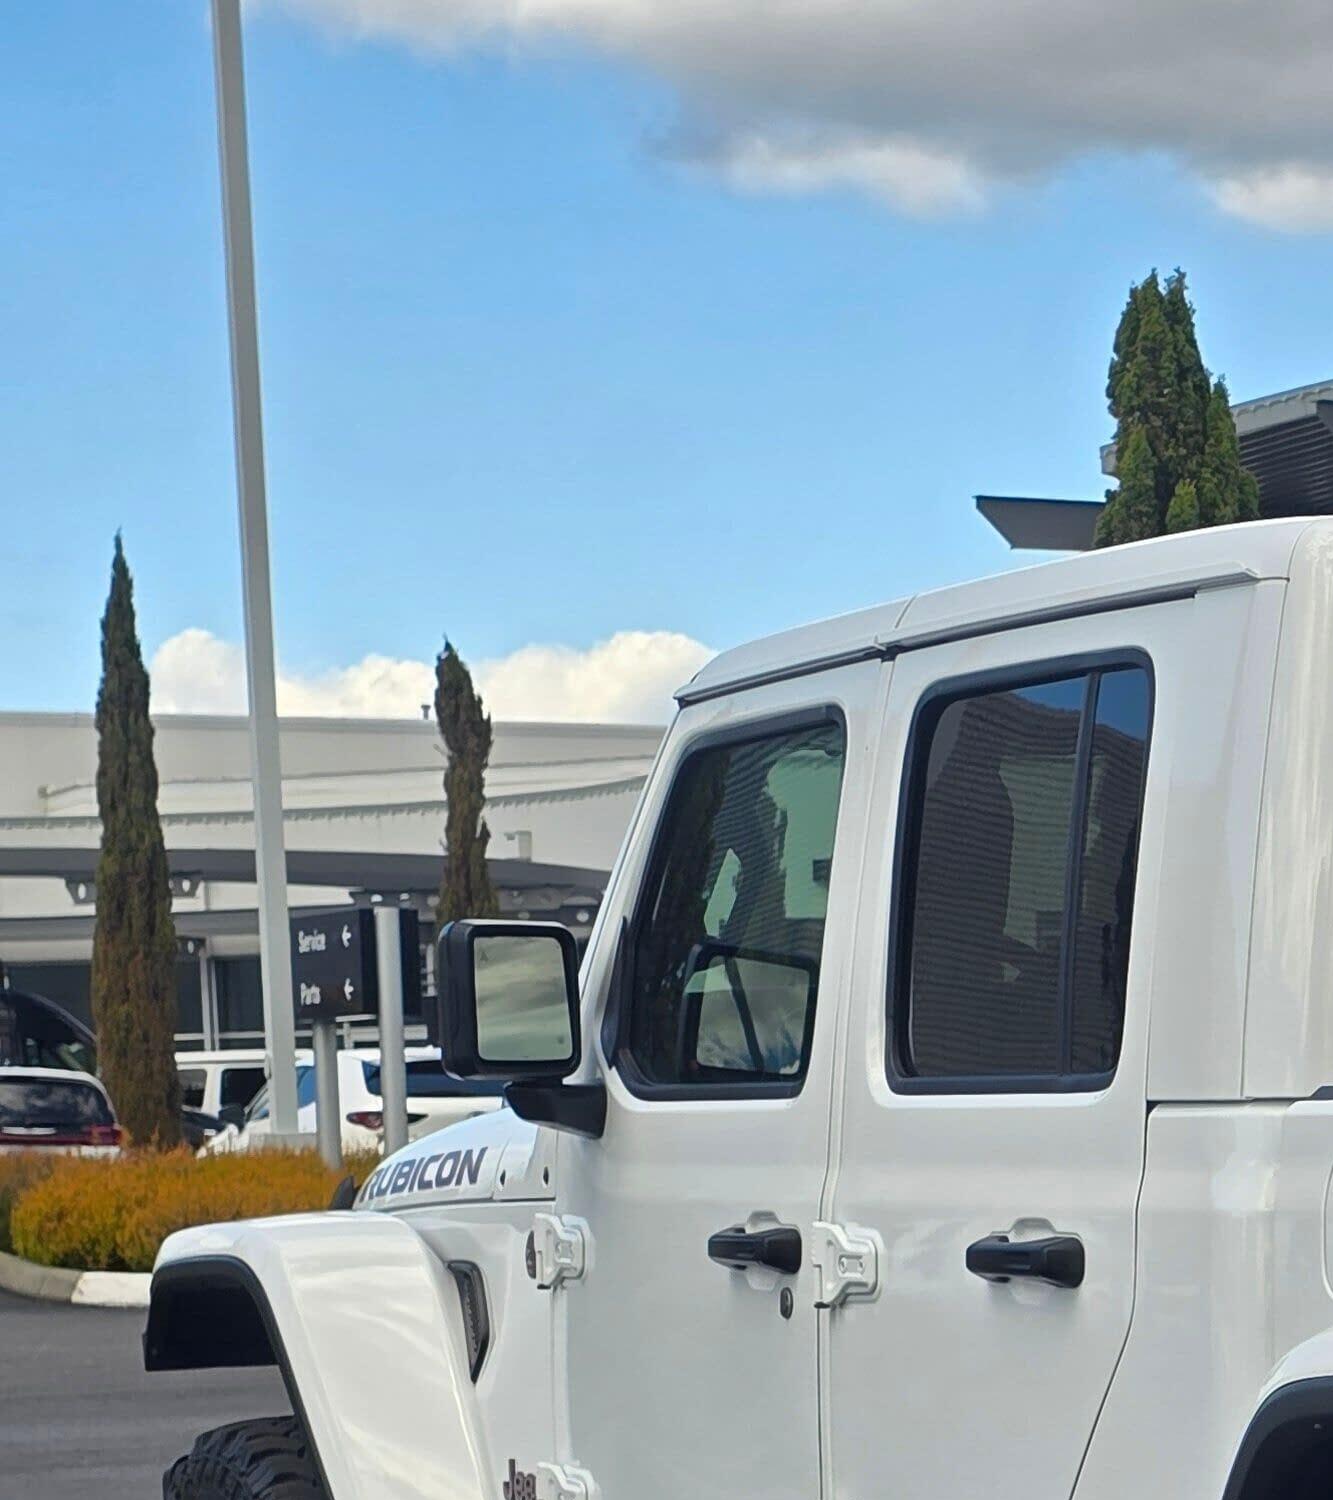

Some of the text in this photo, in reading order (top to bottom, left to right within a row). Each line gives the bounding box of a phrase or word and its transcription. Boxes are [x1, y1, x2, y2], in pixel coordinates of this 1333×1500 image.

[298, 929, 327, 954] Service
[300, 983, 321, 1006] Parts
[360, 1146, 488, 1203] RUBICON
